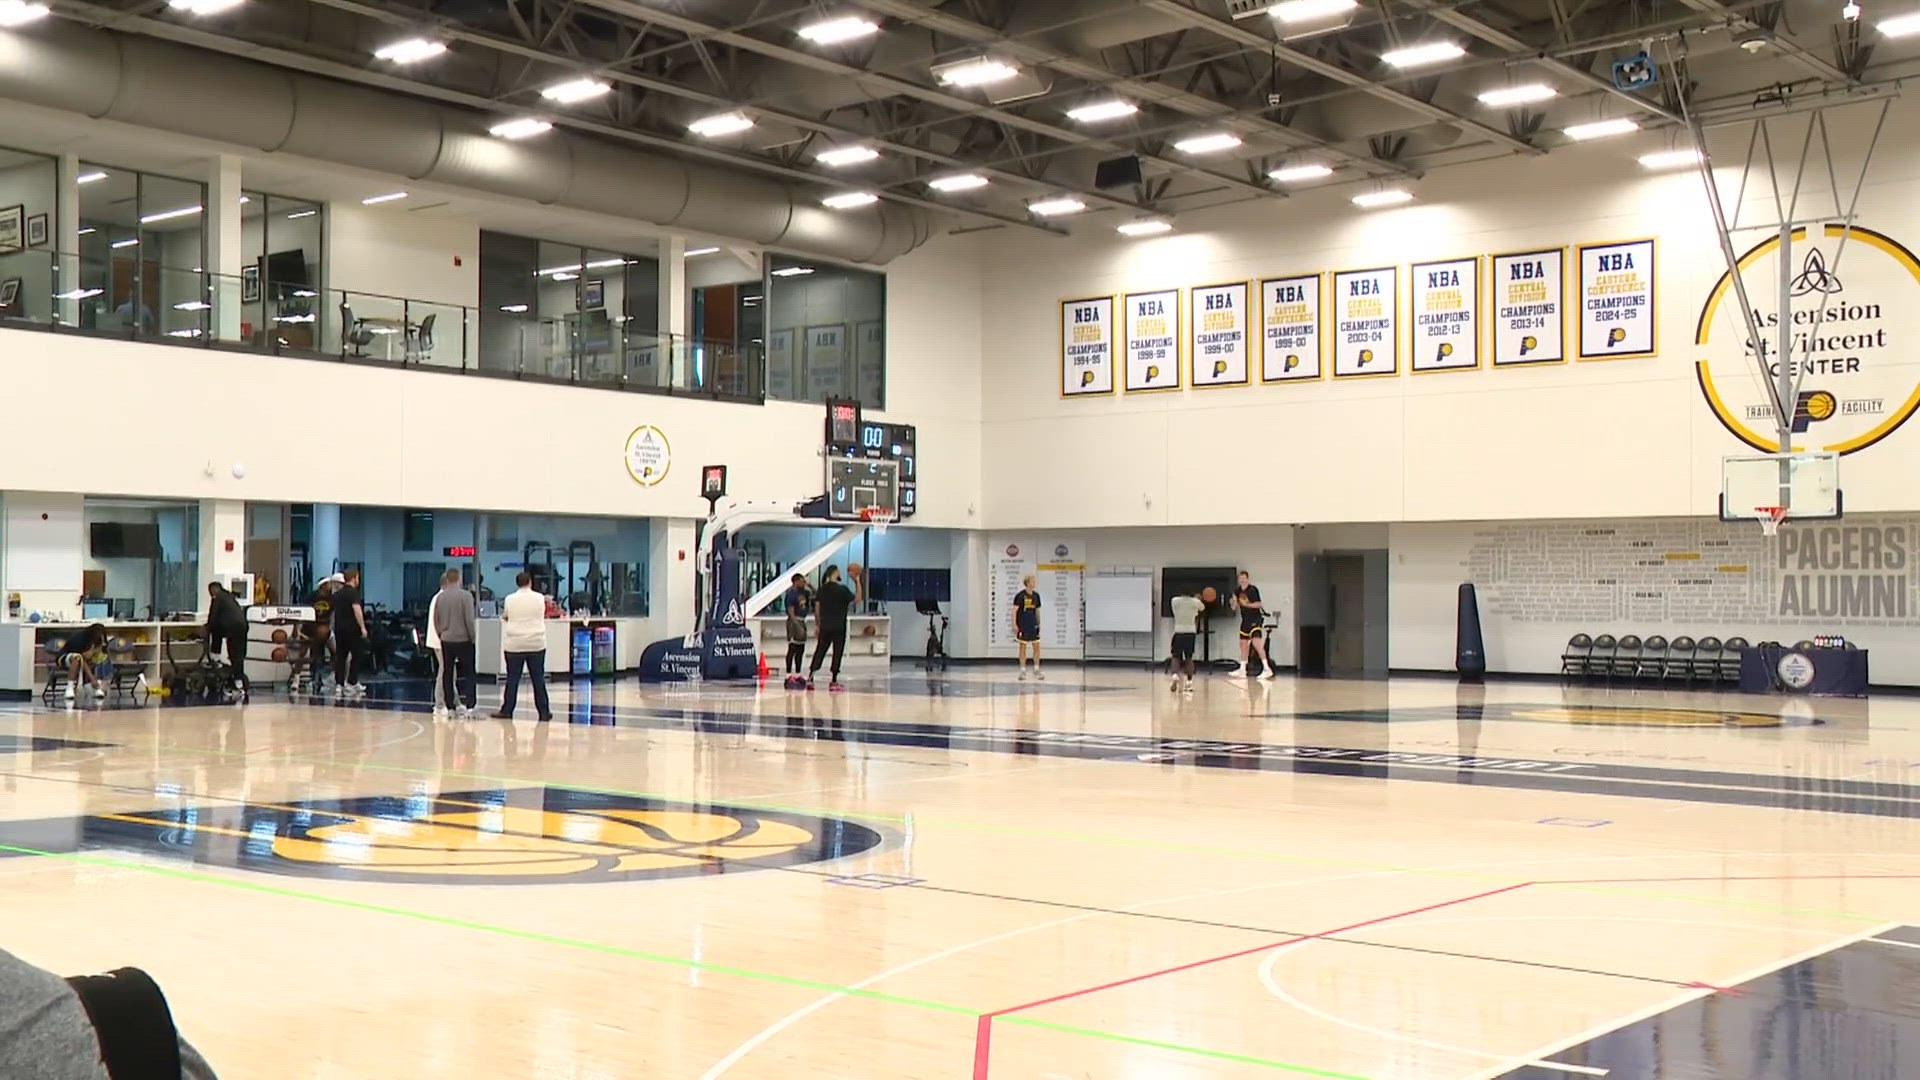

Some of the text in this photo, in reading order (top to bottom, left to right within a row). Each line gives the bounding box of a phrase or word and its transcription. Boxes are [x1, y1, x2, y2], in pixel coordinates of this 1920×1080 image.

[1598, 253, 1634, 272] NBA
[1510, 261, 1544, 280] NBA
[1428, 270, 1459, 288] NBA
[1596, 273, 1636, 285] EASTERN
[1350, 279, 1379, 296] NBA
[1509, 282, 1546, 293] CENTRAL
[1588, 282, 1645, 296] CONFERENCE
[1276, 286, 1304, 303] NBA
[1426, 290, 1461, 300] CENTRAL
[1139, 300, 1164, 316] NBA
[1206, 293, 1232, 310] NBA
[1348, 298, 1382, 309] CENTRAL
[1588, 295, 1645, 310] CHAMPIONS
[1075, 307, 1099, 323] NBA
[1275, 304, 1306, 315] EASTERN
[1500, 304, 1555, 318] CHAMPIONS
[1596, 309, 1636, 322] 2024-25
[1750, 300, 1881, 328] Asension
[1137, 318, 1165, 328] CENTRAL
[1204, 311, 1234, 322] CENTRAL
[1268, 313, 1313, 325] CONFERENCE
[1418, 311, 1470, 325] CHAMPIONS
[1073, 324, 1100, 334] CENTRAL
[1340, 319, 1389, 332] CHAMPIONS
[1428, 324, 1460, 336] 2012-13
[1511, 318, 1544, 330] 2013-14
[1198, 331, 1241, 344] CHAMPIONS
[1268, 325, 1314, 338] CHAMPIONS
[1348, 332, 1382, 344] 2003-04
[1067, 342, 1107, 355] CHAMPIONS
[1131, 337, 1172, 350] CHAMPIONS
[1205, 343, 1234, 354] 1999-00
[1275, 338, 1306, 348] 1999-00
[1842, 401, 1883, 415] FACILITY
[1779, 527, 1905, 569] PACERS
[1780, 575, 1906, 618] ALUMNI
[715, 635, 753, 645] Ascension
[662, 652, 700, 662] Ascension
[714, 647, 755, 657] St. Vincent
[660, 663, 700, 674] St. Vincent
[1360, 752, 1597, 772] COURT
